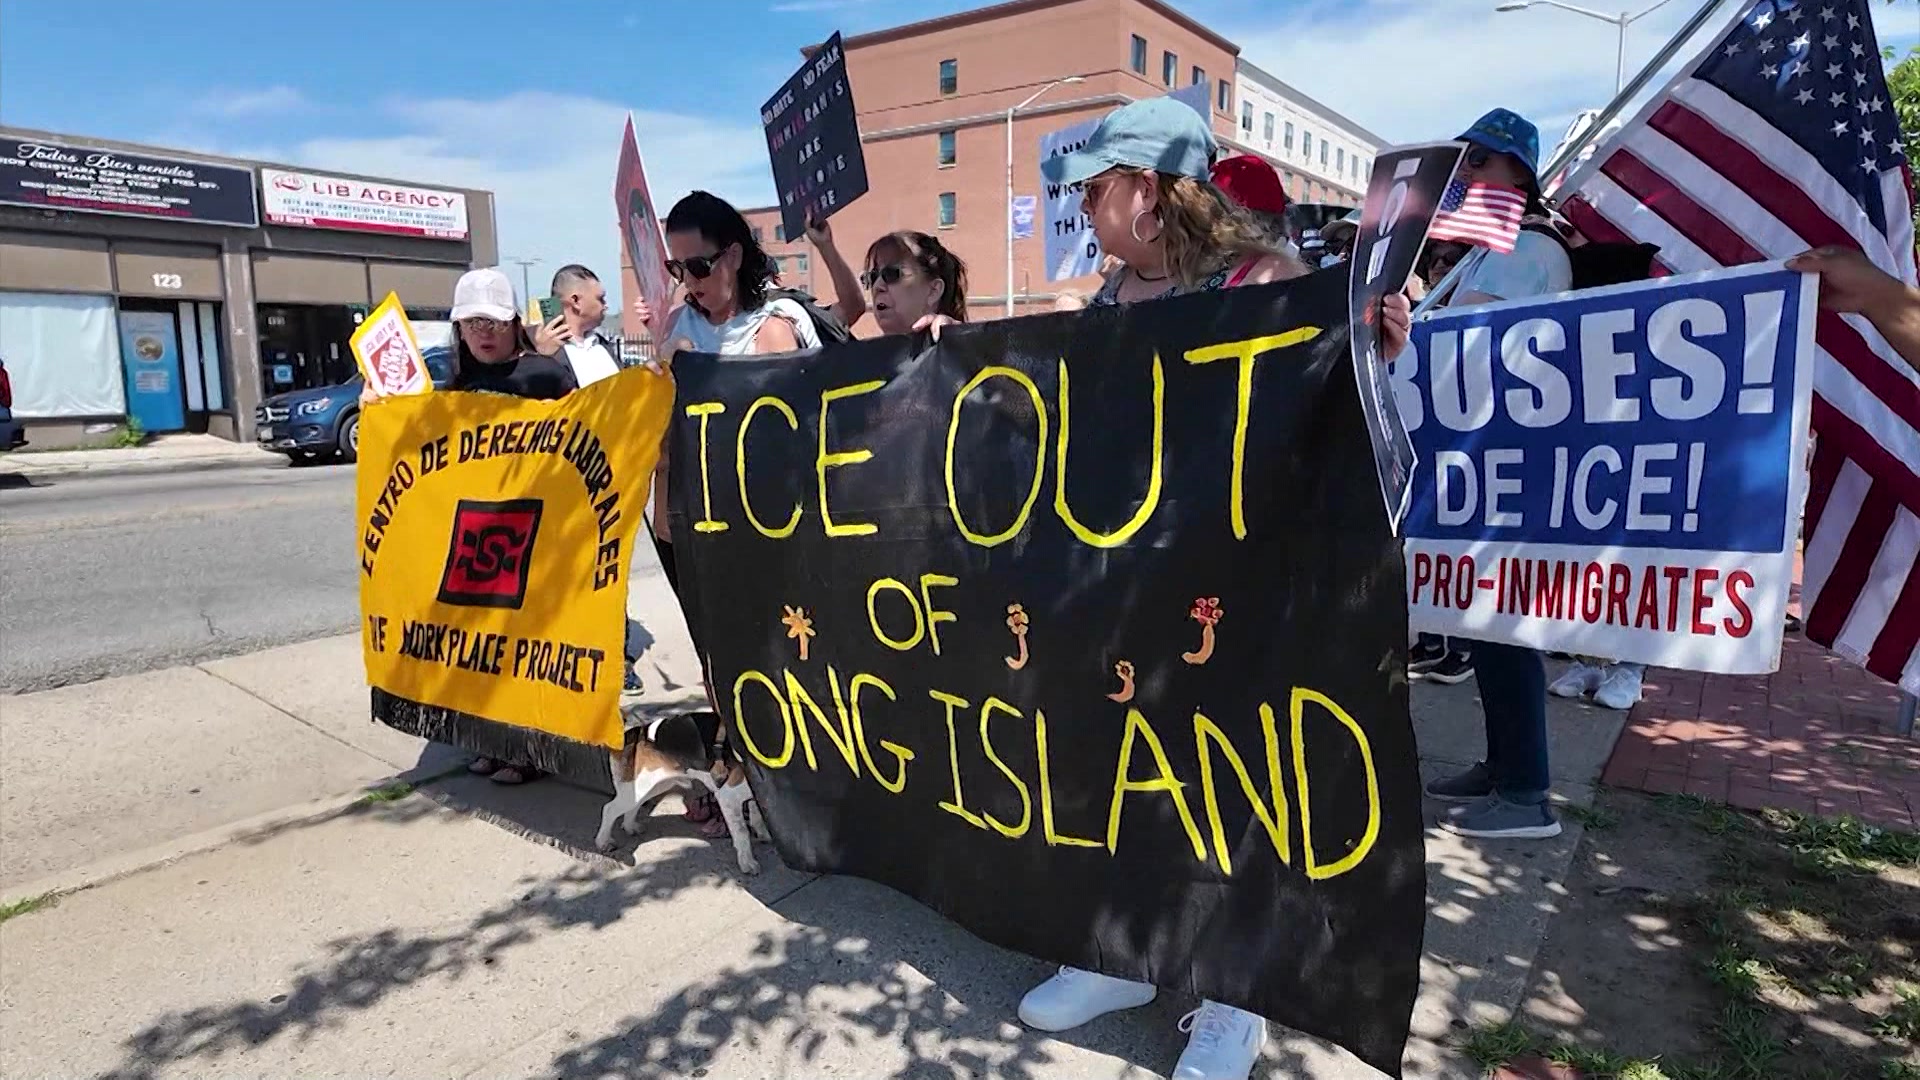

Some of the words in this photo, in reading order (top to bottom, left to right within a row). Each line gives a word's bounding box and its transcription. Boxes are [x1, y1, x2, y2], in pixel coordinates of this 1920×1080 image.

[771, 79, 844, 152] IMMIGRANTS
[772, 89, 794, 118] HATE
[802, 69, 815, 90] NO
[815, 45, 840, 77] FEAR
[17, 143, 79, 163] Todos
[85, 154, 136, 171] Bien
[137, 162, 195, 178] venidos
[785, 154, 846, 206] WELCOME
[798, 136, 823, 165] ARE
[313, 182, 350, 197] LIB
[361, 188, 455, 208] AGENCY
[152, 273, 182, 289] 123
[686, 379, 888, 538] ICE
[945, 325, 1324, 548] OUT
[418, 434, 450, 476] DE
[457, 417, 569, 463] DERECHOS
[562, 421, 621, 591] LABORALES
[1435, 448, 1524, 527] DE
[1548, 442, 1706, 532] ICE!
[866, 573, 959, 656] OF
[1412, 553, 1754, 639] PRO-INMIGRATES
[368, 614, 388, 653] TE
[398, 619, 508, 676] WORKPLACE
[512, 638, 605, 693] PROJECT
[733, 663, 915, 794] ONG
[929, 686, 1381, 880] ISLAND
